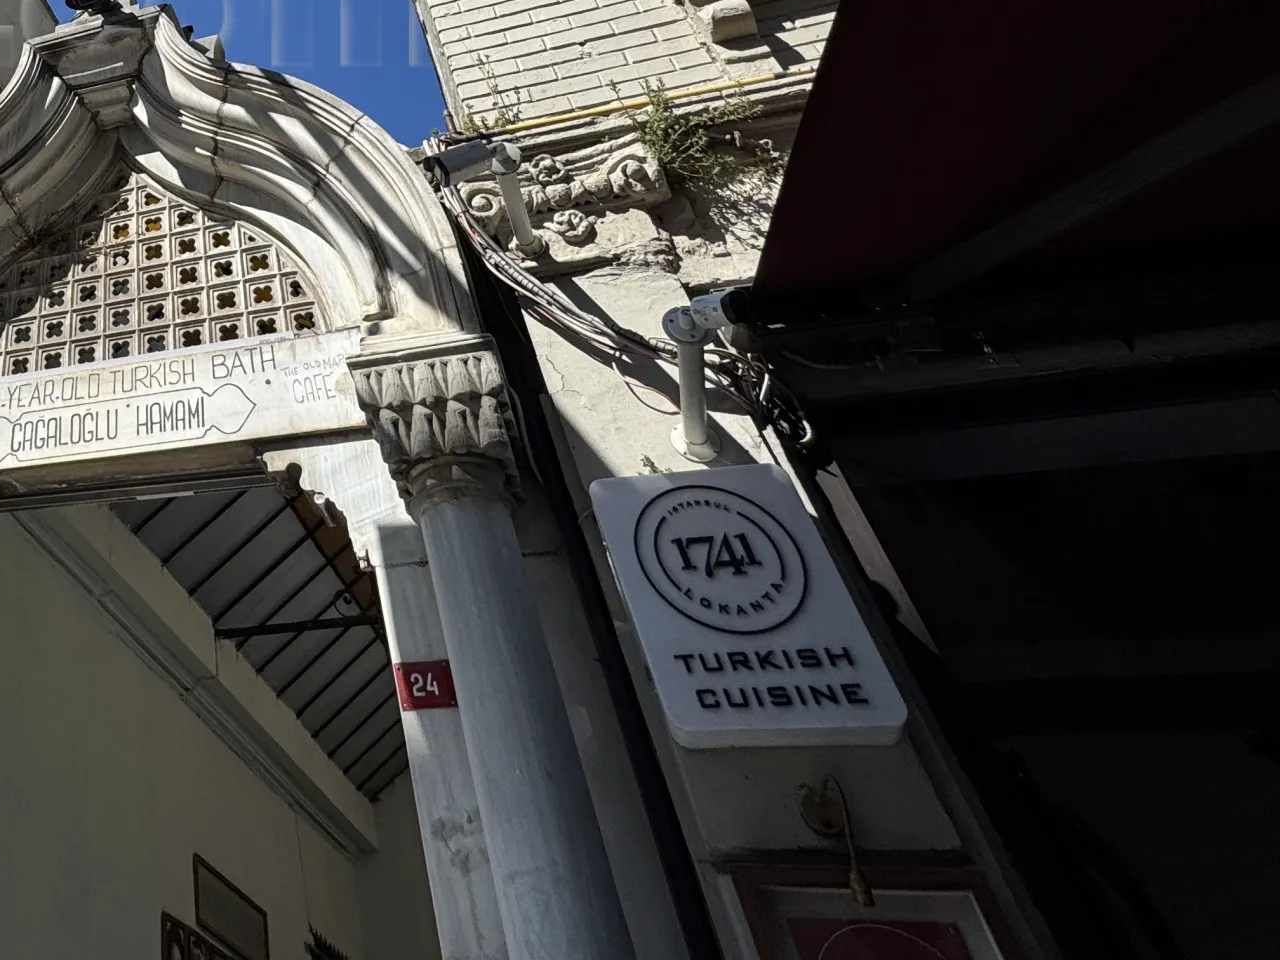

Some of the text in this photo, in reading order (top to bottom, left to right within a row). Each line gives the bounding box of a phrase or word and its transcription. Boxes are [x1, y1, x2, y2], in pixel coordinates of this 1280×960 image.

[110, 358, 195, 395] TURKISH
[211, 344, 277, 380] BATH
[280, 366, 299, 377] THE
[302, 359, 321, 371] OLD
[10, 396, 206, 453] CAĞALOĞLU HAMAMI
[670, 531, 763, 578] 1741
[681, 579, 785, 616] LOKANTA
[673, 646, 856, 674] TURKISH
[409, 671, 440, 698] 24
[695, 682, 870, 710] CUISINE
